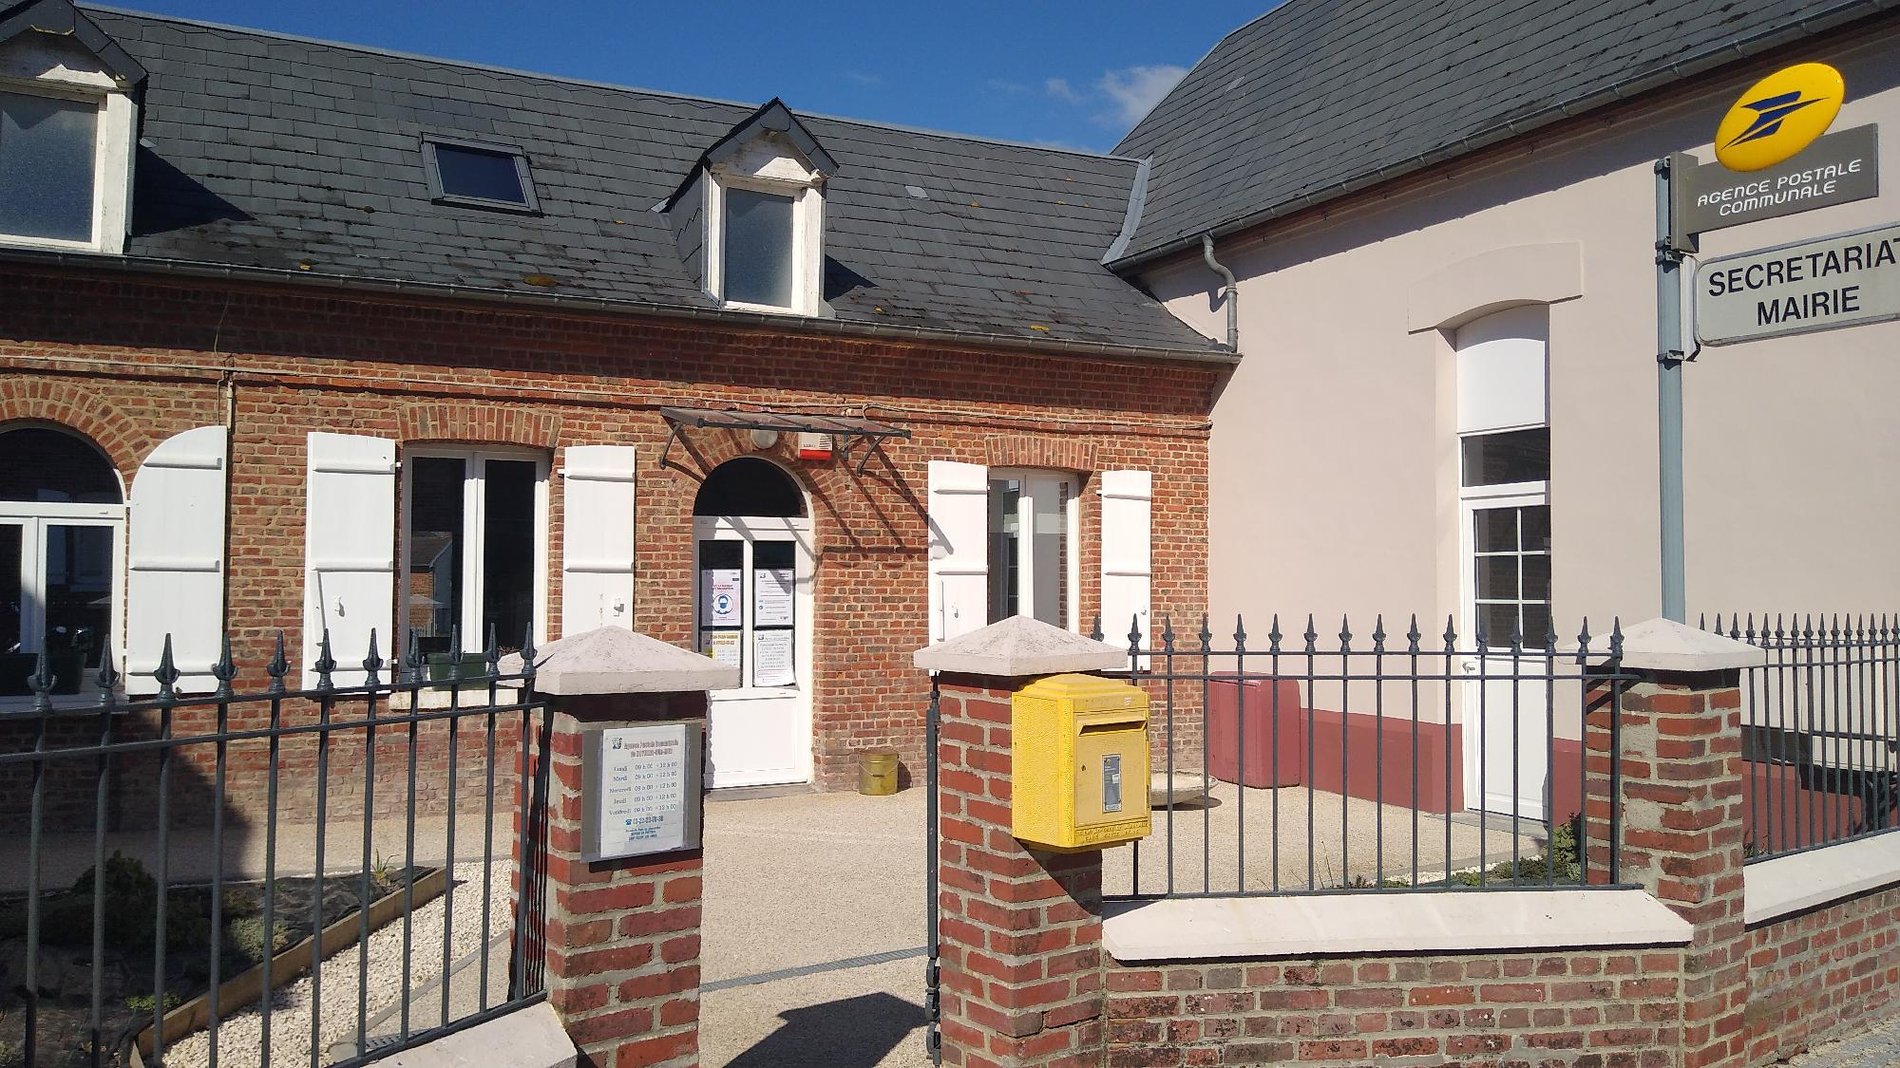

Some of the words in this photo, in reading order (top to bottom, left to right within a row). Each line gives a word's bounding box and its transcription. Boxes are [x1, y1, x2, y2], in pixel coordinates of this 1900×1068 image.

[1697, 179, 1771, 207] AGENCE
[1777, 158, 1862, 190] POSTALE
[1719, 180, 1837, 216] COMMUNALE
[1708, 237, 1900, 297] SECRETARIA
[1757, 285, 1860, 326] MAIRIE
